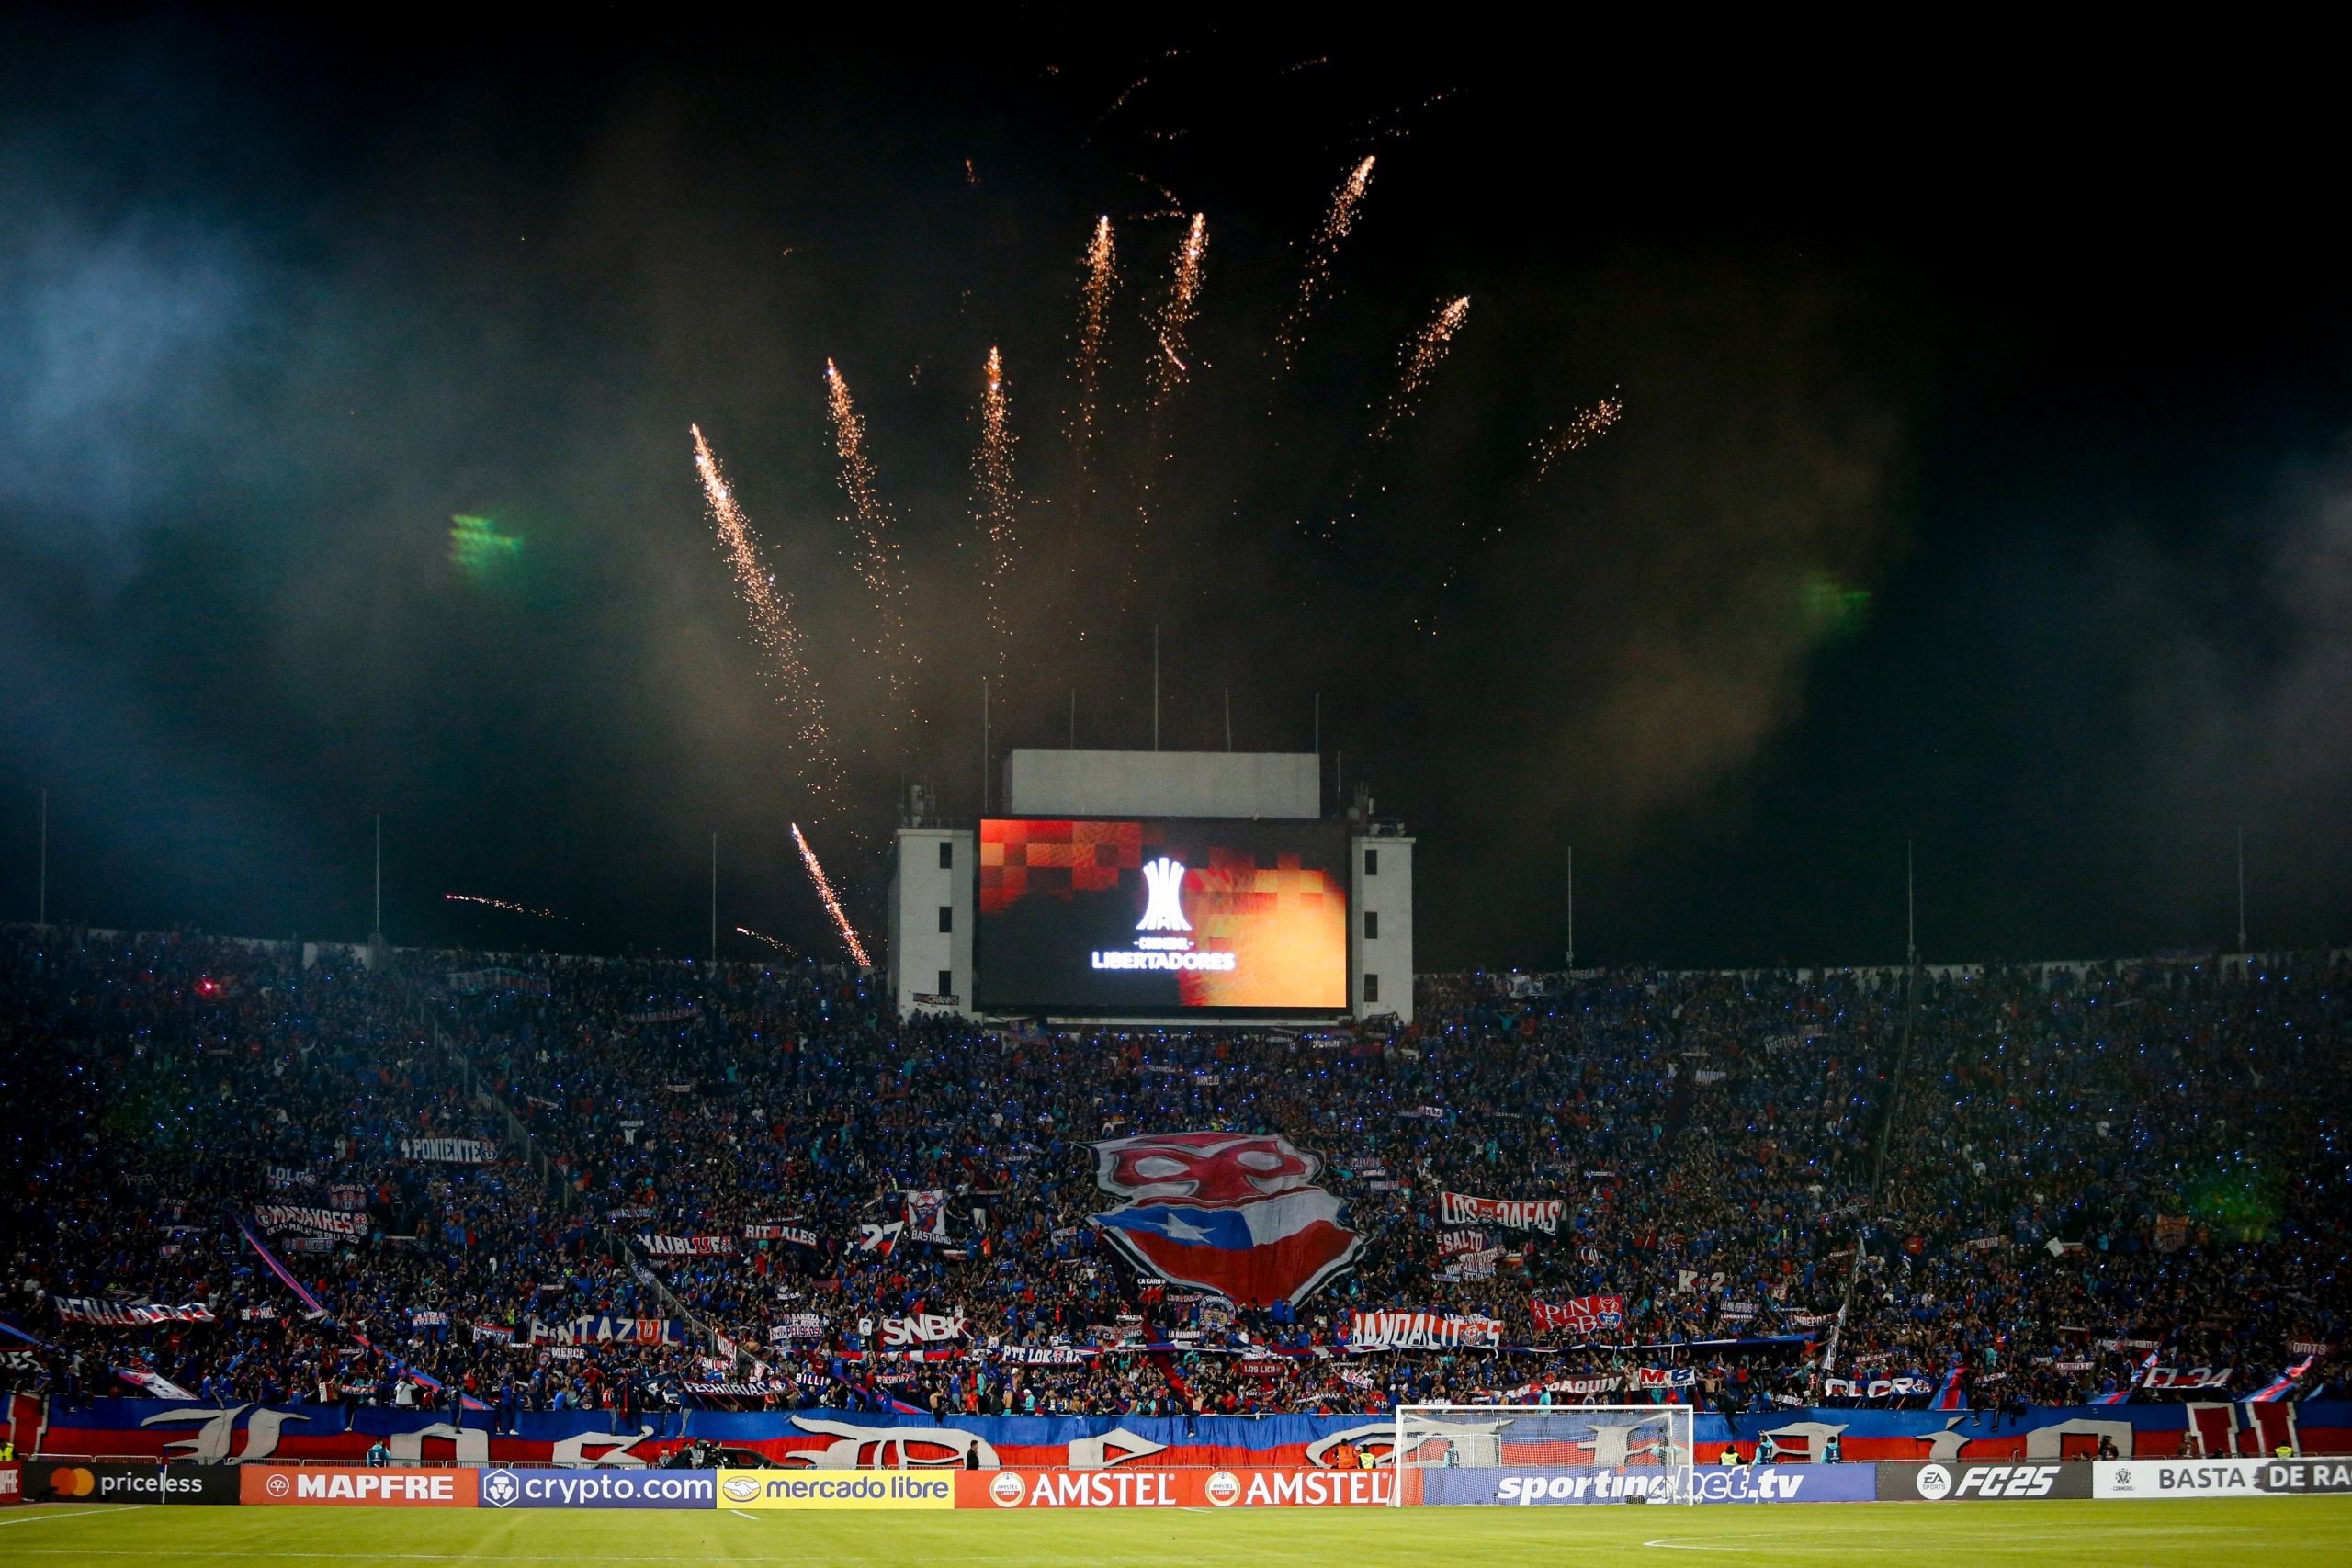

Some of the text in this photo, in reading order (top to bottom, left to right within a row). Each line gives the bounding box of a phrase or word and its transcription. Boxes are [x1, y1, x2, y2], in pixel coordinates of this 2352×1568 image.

[1091, 951, 1236, 970] LIBERTADORES
[413, 1138, 482, 1162] PONIENTE
[1442, 1193, 1478, 1225] LOS
[745, 1225, 817, 1246] RITUALES
[861, 1221, 905, 1251] 27
[1443, 1229, 1484, 1252] SALTO
[1679, 1269, 1725, 1292] K 2
[530, 1314, 681, 1346] PNTAZUL
[882, 1313, 975, 1346] SNBK
[683, 1381, 769, 1395] FECHORIAS
[1545, 1376, 1623, 1394] OAQUIN
[101, 1472, 202, 1495] priceless
[298, 1474, 454, 1500] MAPFRE
[526, 1474, 713, 1504] crypto.com
[766, 1475, 949, 1499] mercado libre
[1030, 1472, 1176, 1506] AMSTEL
[1245, 1472, 1389, 1505] AMSTEL
[1923, 1472, 1945, 1484] EA
[2159, 1465, 2352, 1489] BASTA DE RA
